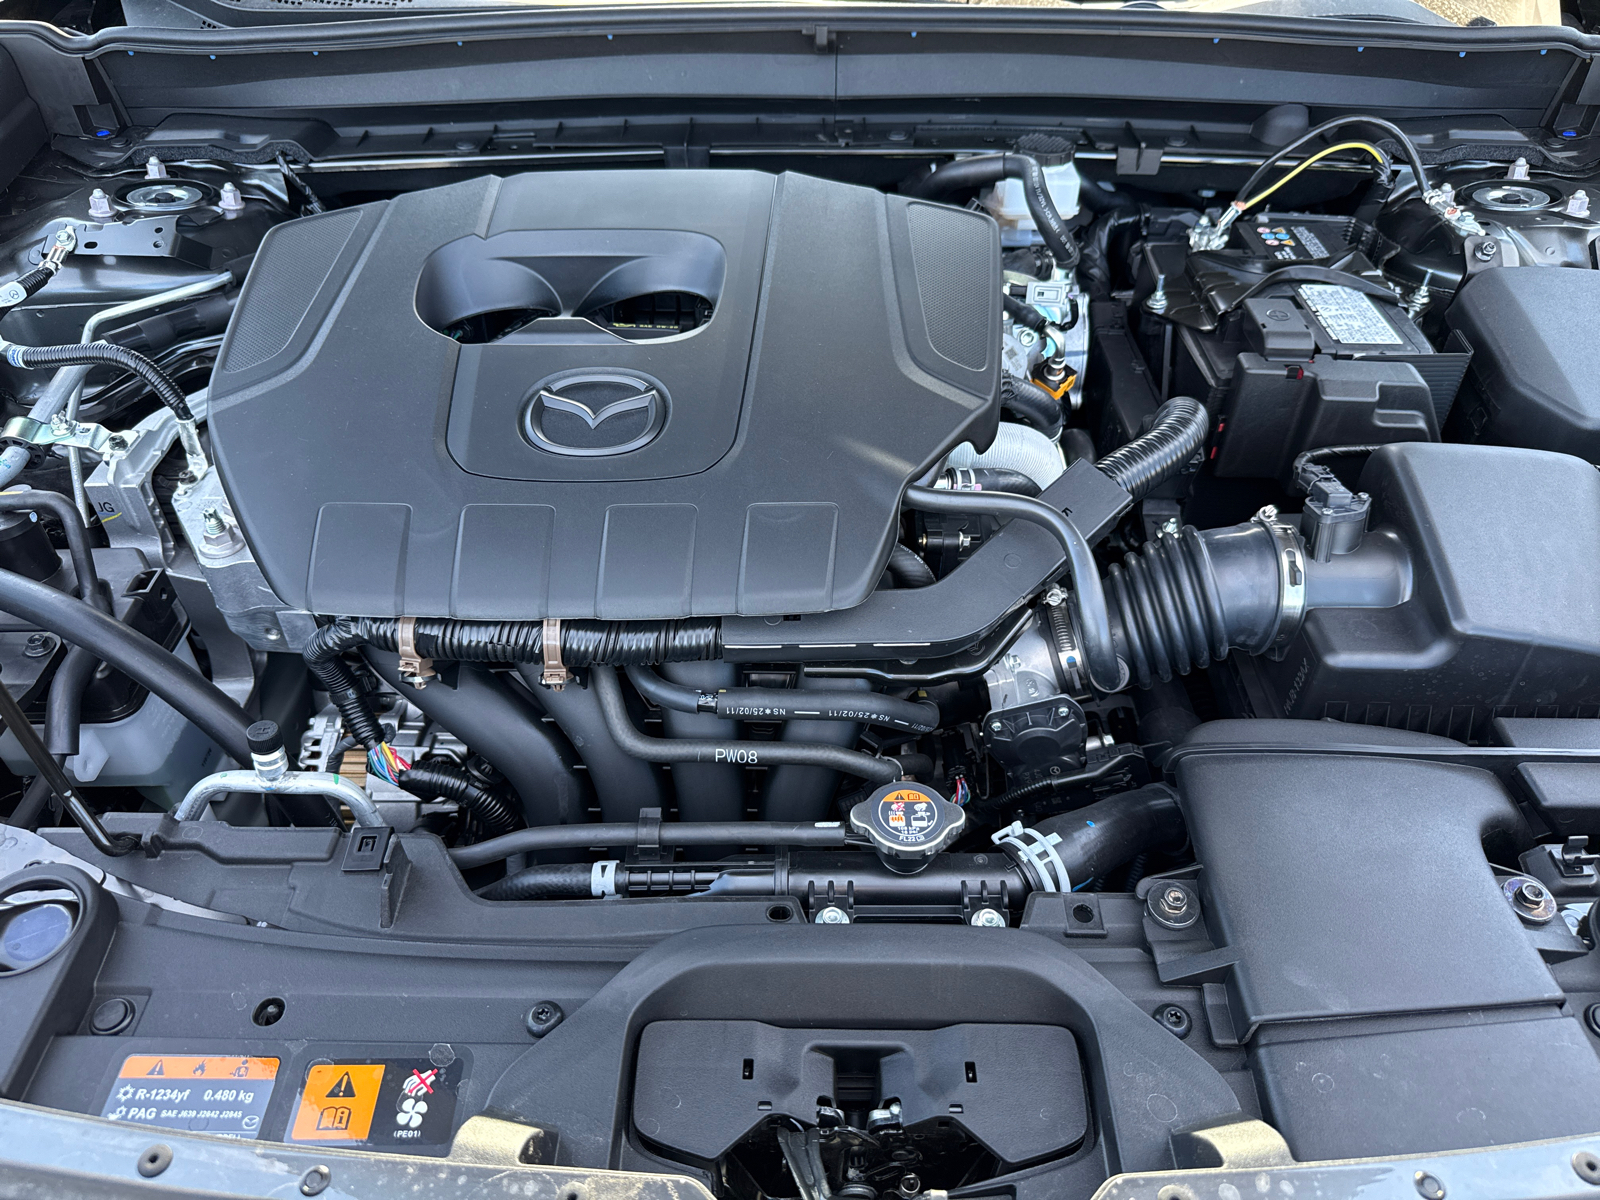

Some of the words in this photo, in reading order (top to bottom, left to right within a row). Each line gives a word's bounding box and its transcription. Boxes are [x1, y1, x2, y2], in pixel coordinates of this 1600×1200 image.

[715, 749, 758, 763] PW08
[135, 1088, 191, 1103] R-1234yf
[204, 1089, 236, 1101] 0.480
[237, 1089, 254, 1103] kg
[127, 1107, 158, 1119] PAG
[160, 1110, 178, 1118] SAE
[393, 1130, 421, 1138] (PE01)
